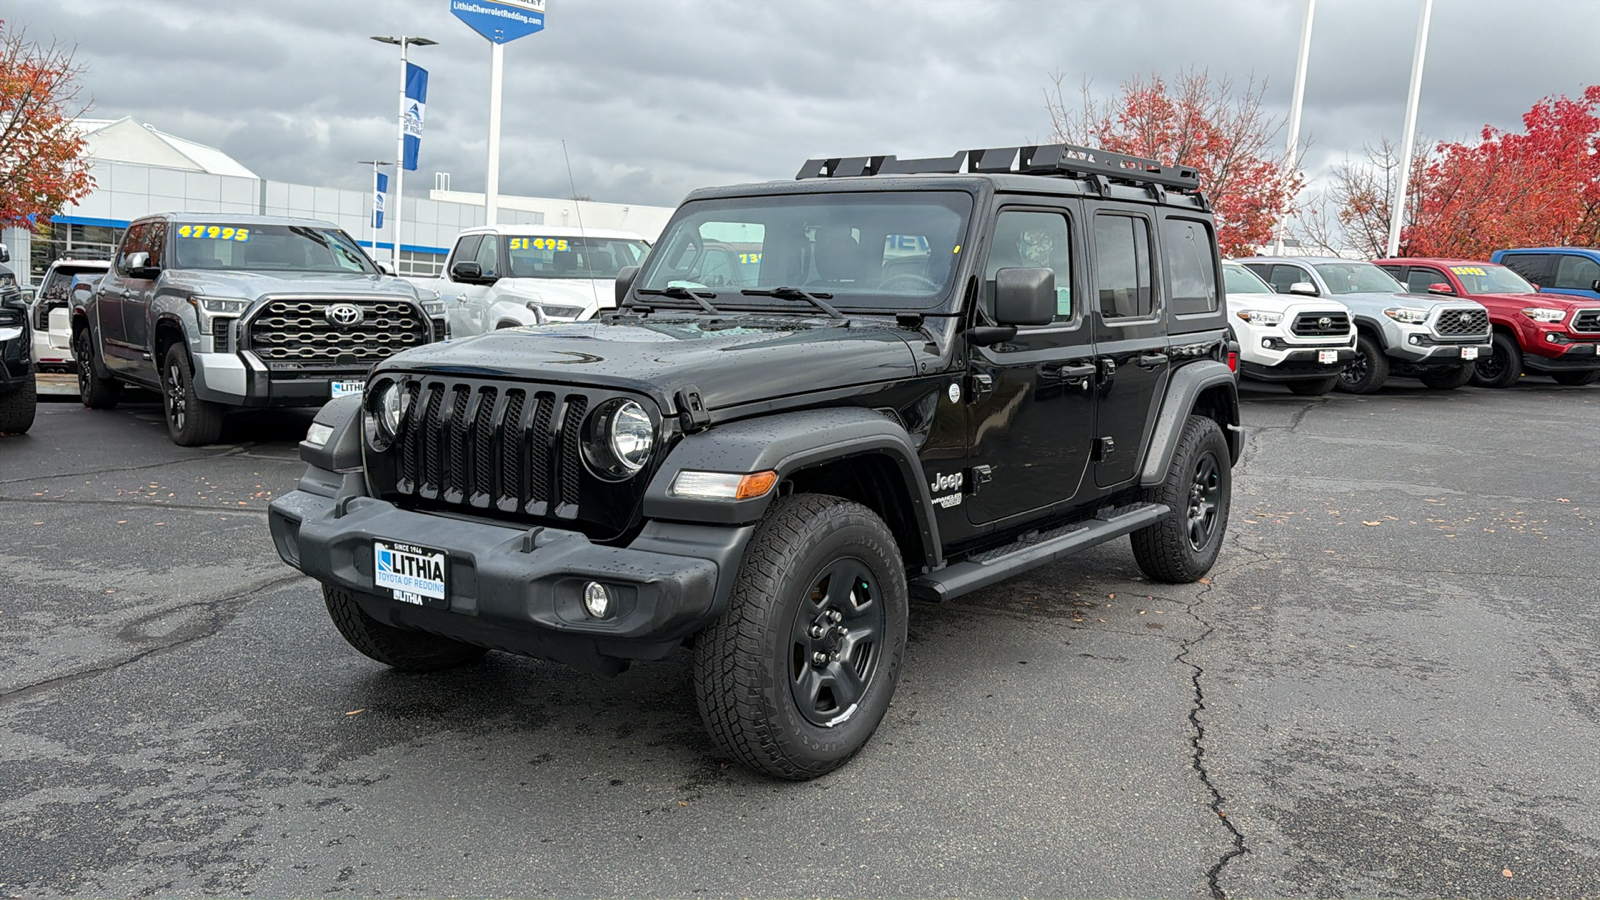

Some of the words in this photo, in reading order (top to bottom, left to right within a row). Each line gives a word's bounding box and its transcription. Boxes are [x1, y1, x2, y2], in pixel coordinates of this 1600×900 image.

[453, 1, 542, 25] LithiaChevroletRedding.com
[178, 225, 250, 241] 47995
[341, 383, 364, 392] LITHI
[931, 472, 963, 492] Jeep
[394, 543, 409, 552] SINCE
[410, 546, 422, 554] 1946
[392, 553, 444, 582] LITHIA
[378, 571, 402, 585] TOYOTA
[403, 576, 413, 586] OF
[414, 579, 444, 593] REDDING
[400, 590, 423, 606] LITHIA
